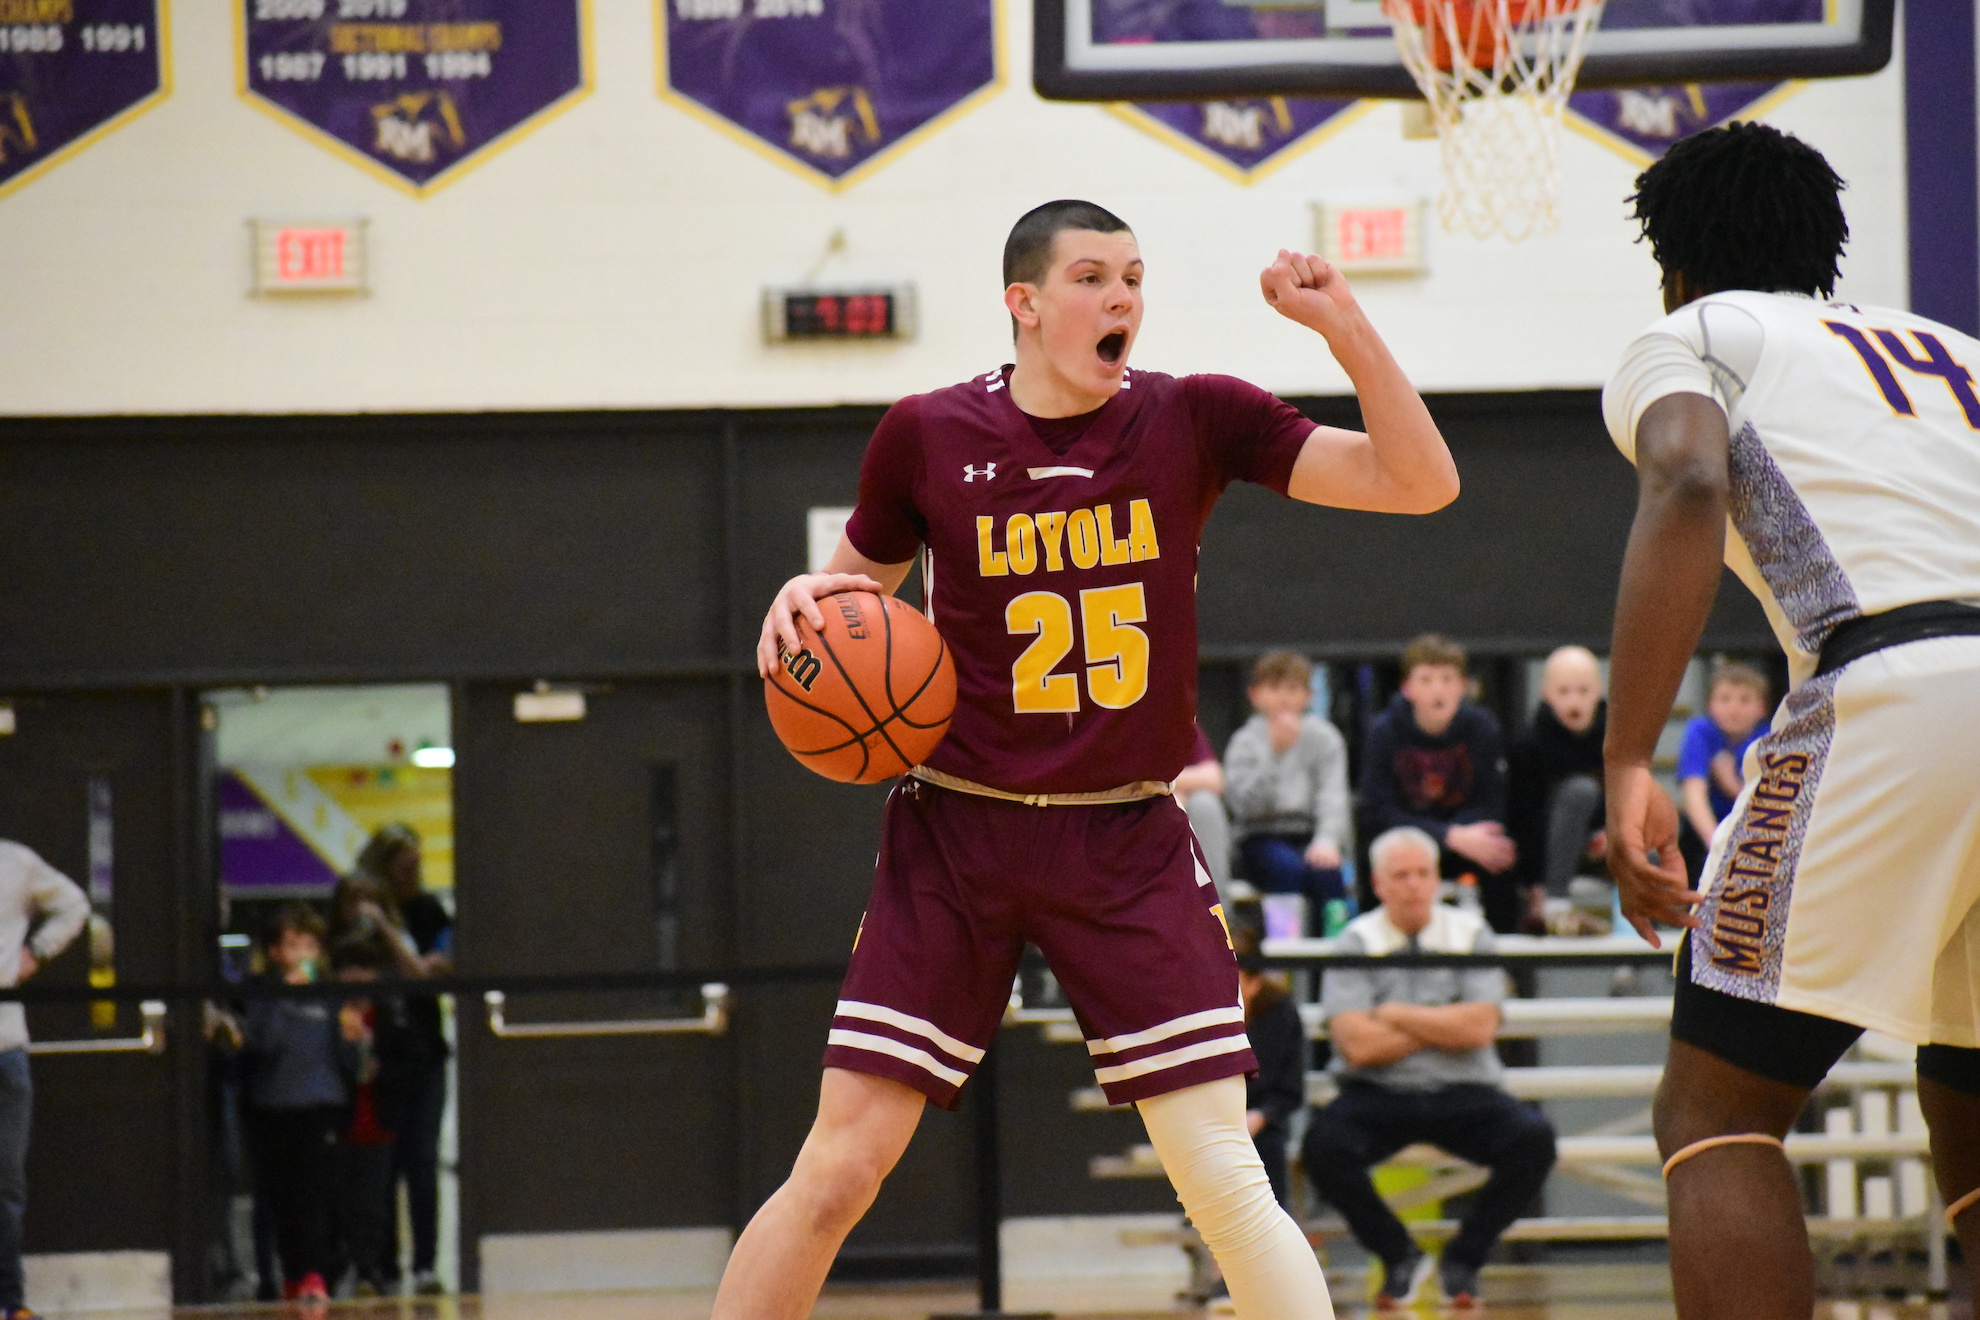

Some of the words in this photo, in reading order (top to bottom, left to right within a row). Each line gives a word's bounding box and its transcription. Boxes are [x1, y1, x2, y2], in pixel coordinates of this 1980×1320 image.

[277, 228, 346, 280] EXIT
[1340, 209, 1405, 260] EXIT
[1819, 318, 1980, 434] 14
[976, 498, 1160, 577] LOYOLA
[1005, 581, 1150, 714] 25
[1710, 752, 1811, 977] MUSTANGS
